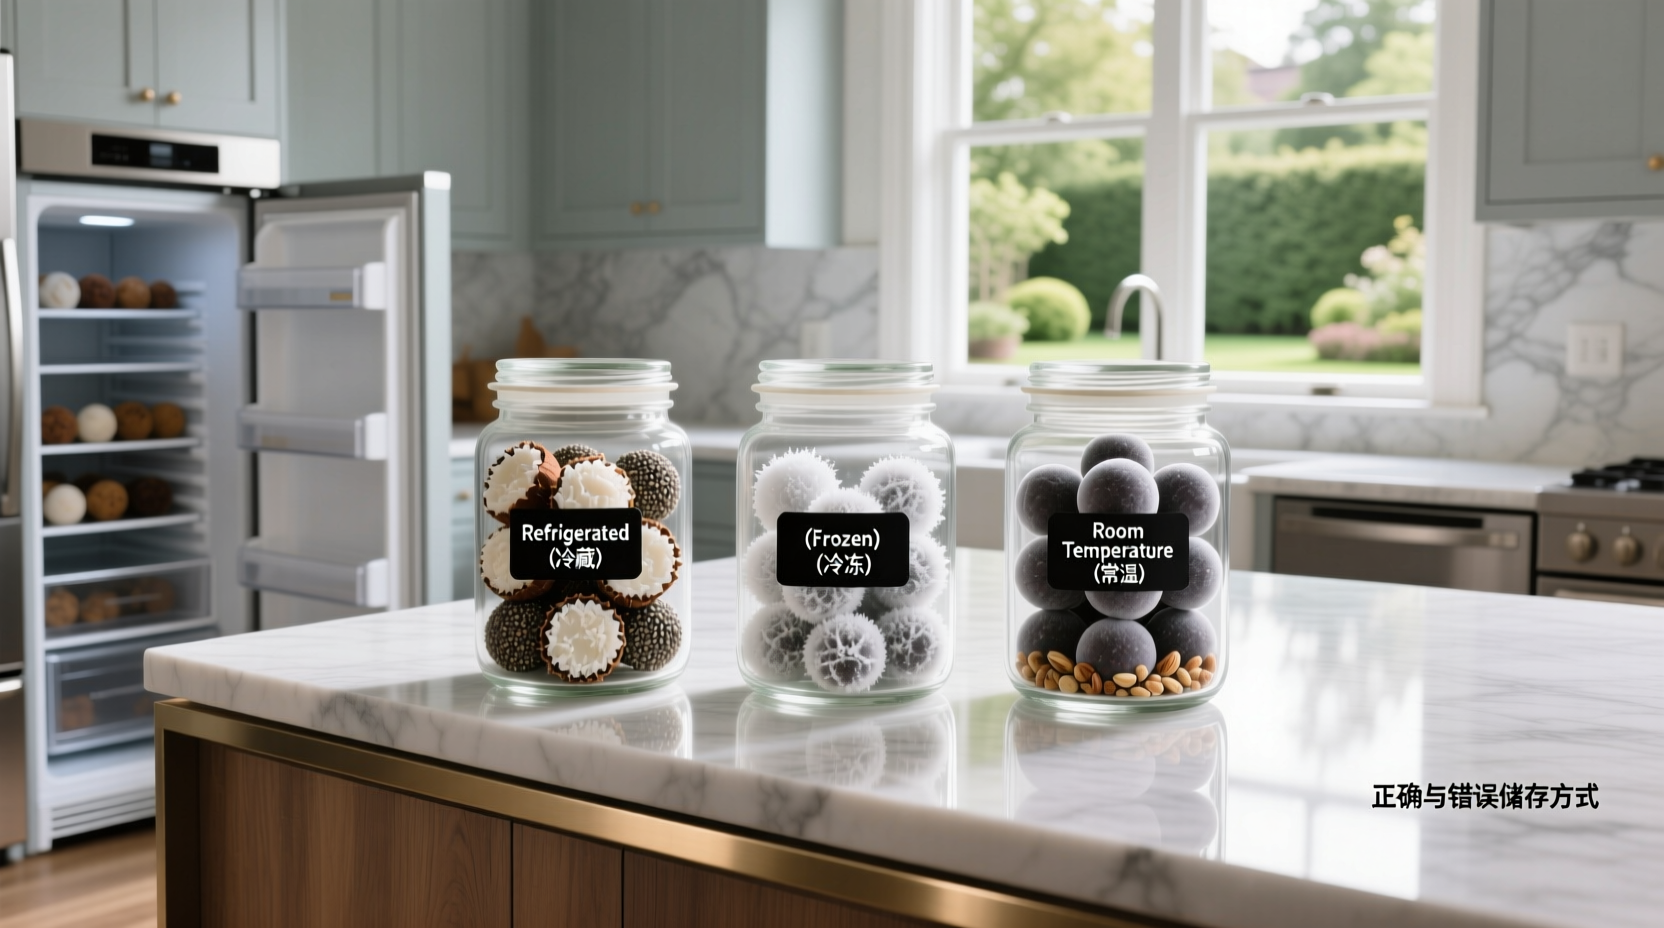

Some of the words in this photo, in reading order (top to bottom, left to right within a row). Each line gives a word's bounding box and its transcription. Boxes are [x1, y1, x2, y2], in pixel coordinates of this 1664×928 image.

[522, 523, 630, 546] Refrigerated
[805, 527, 880, 550] (Frozen)
[1093, 522, 1144, 539] Room
[1062, 541, 1174, 563] Temperature
[817, 552, 871, 576] (冷冻)
[1094, 563, 1145, 585] (常温)
